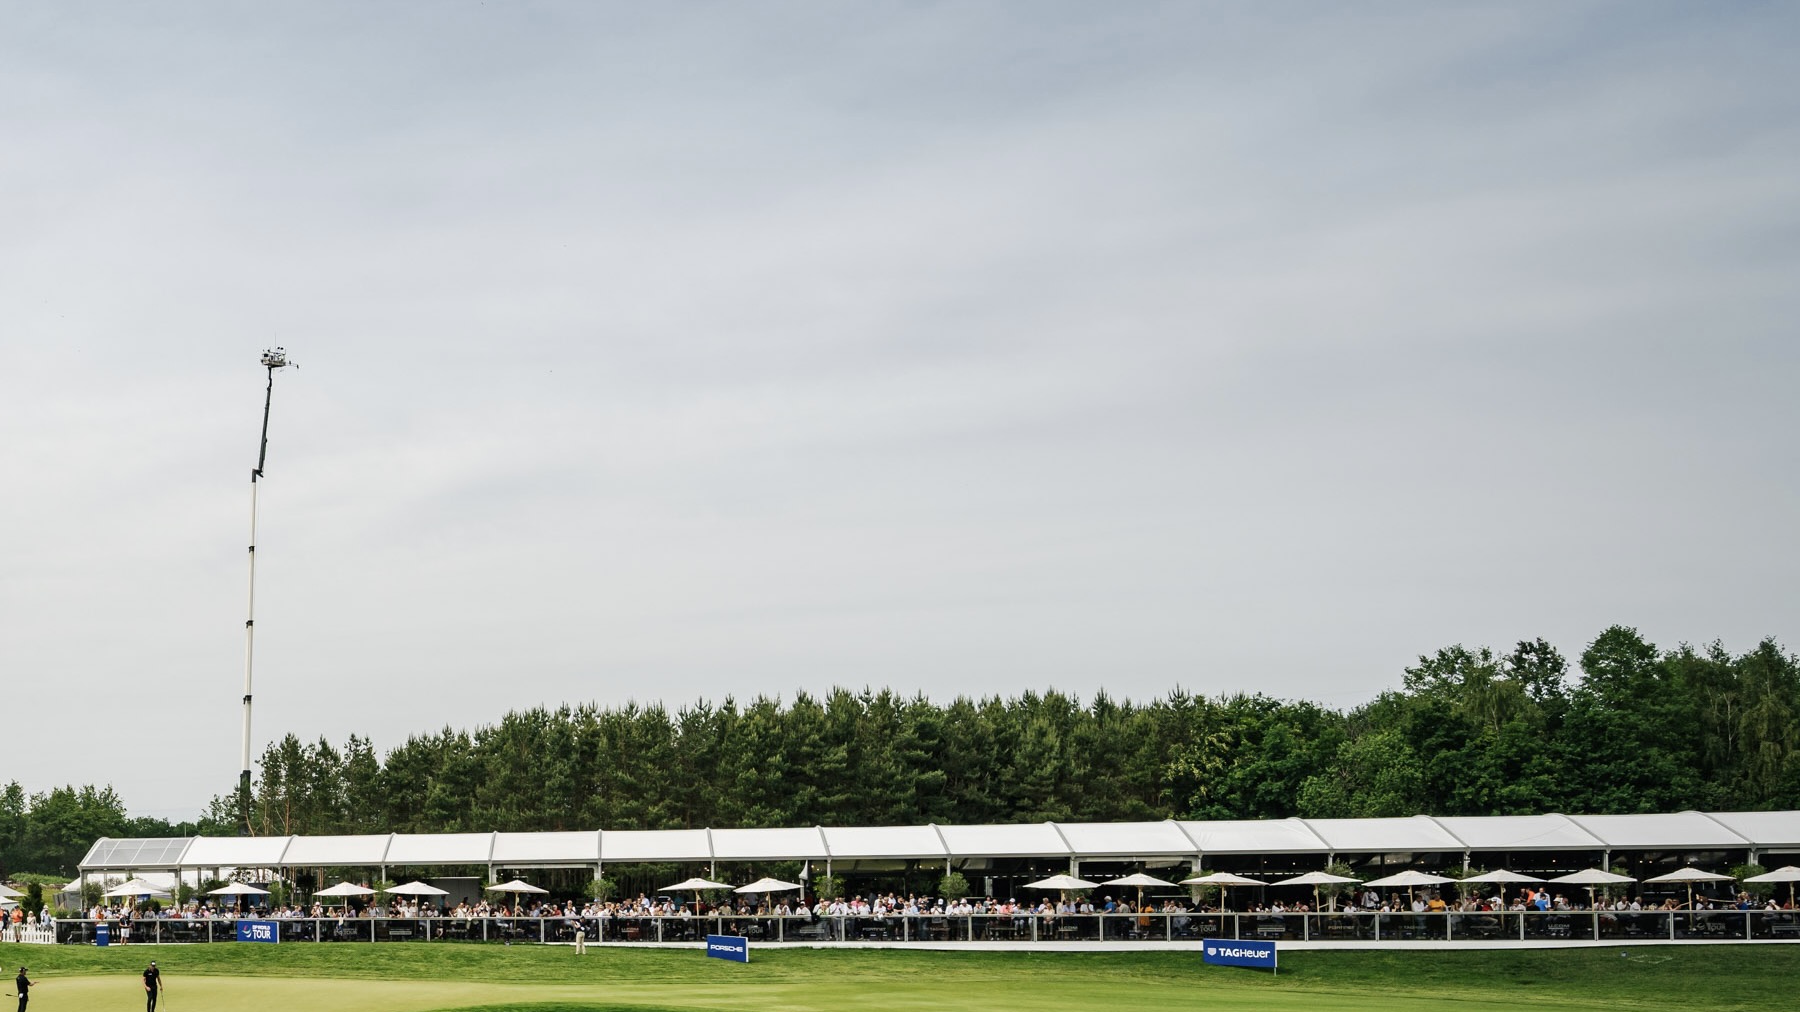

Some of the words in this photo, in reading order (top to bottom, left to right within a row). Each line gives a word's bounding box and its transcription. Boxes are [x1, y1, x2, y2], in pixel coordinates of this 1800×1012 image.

[252, 930, 271, 939] TOUR
[710, 944, 743, 953] PORSCHE
[1218, 947, 1271, 959] TAGHeuer
